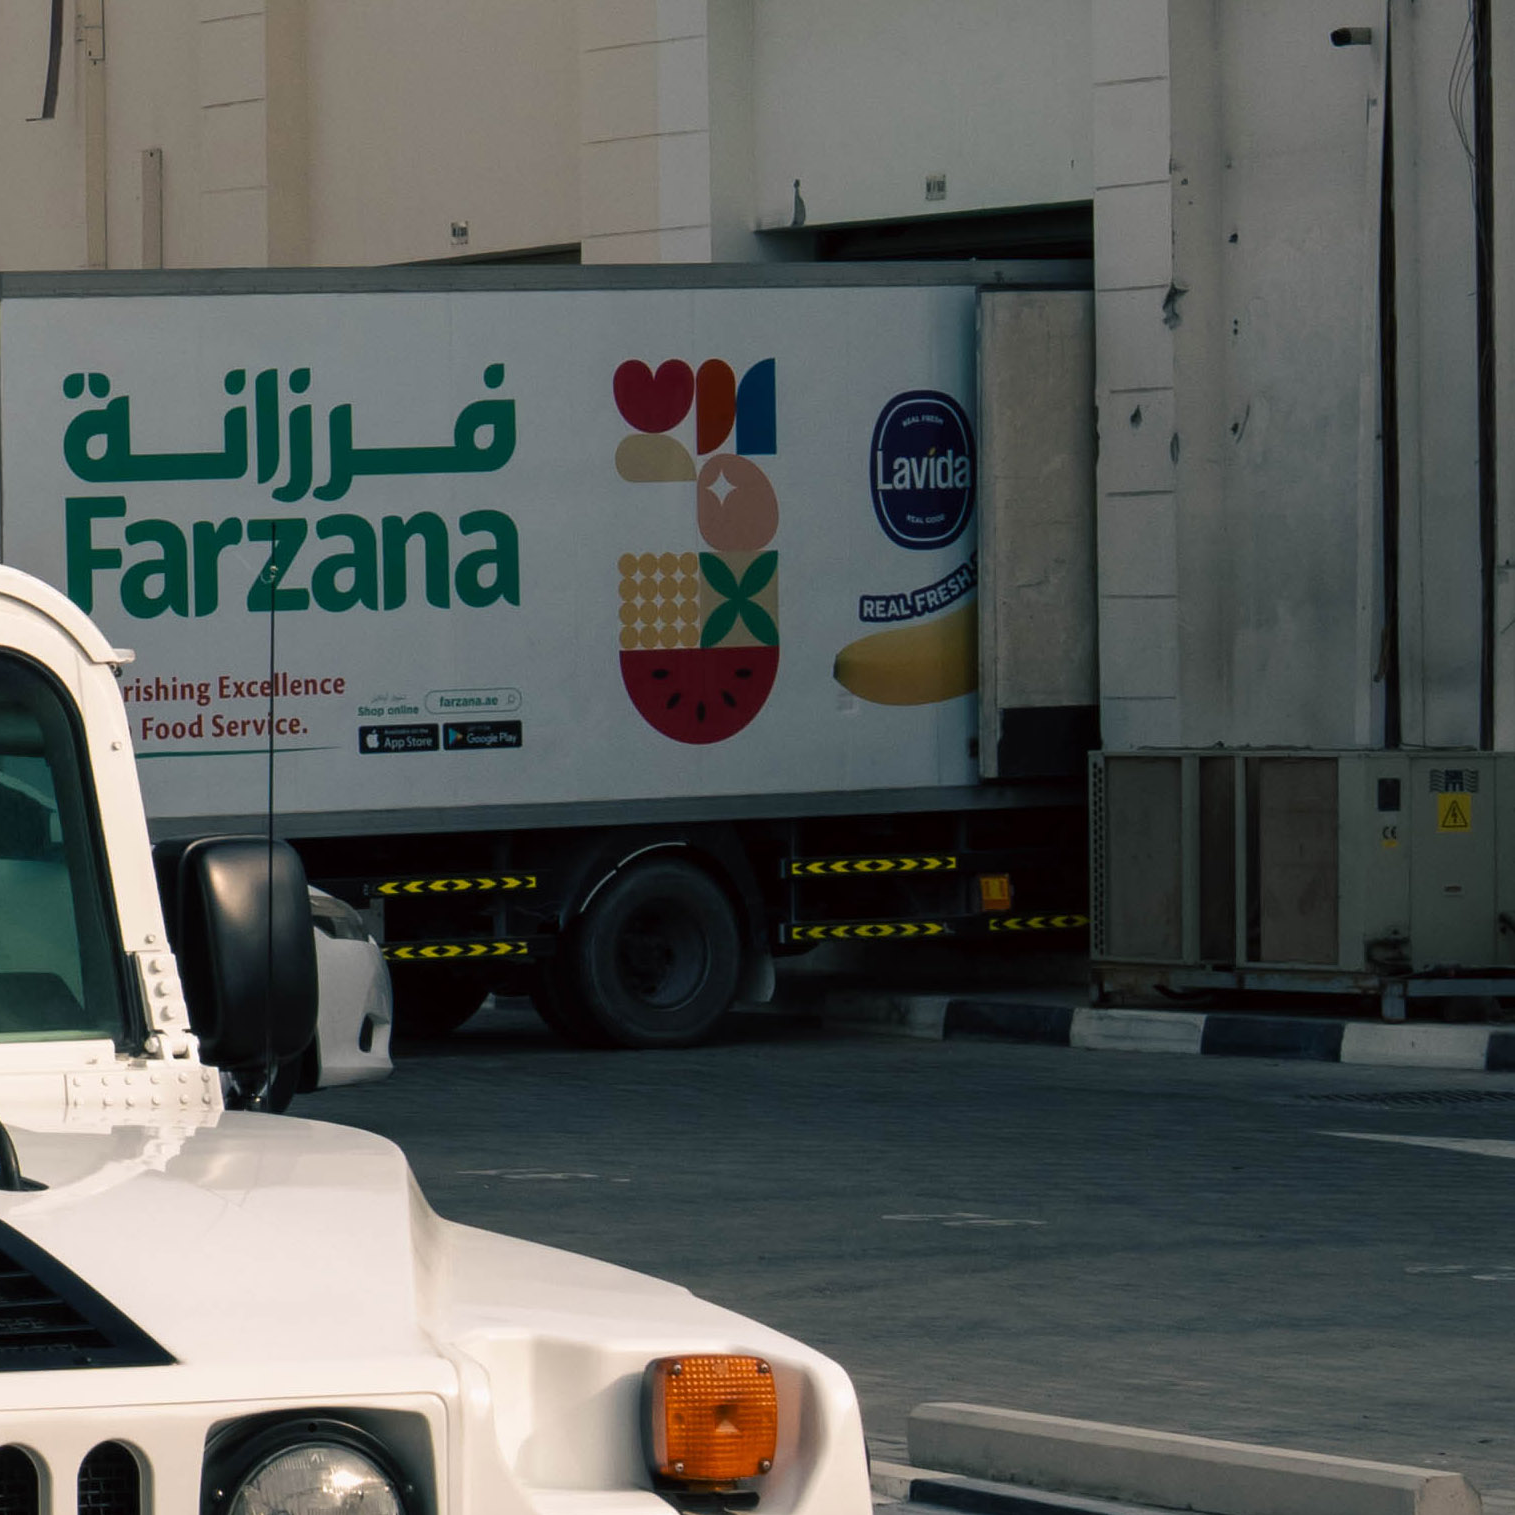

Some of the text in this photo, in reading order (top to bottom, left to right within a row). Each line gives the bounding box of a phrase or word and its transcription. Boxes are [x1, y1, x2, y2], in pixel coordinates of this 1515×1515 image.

[63, 363, 516, 502] فرزانة
[65, 495, 521, 619] Farzana
[862, 569, 970, 619] REAL FRESH
[123, 671, 346, 706] rishing Excellence
[439, 695, 499, 708] farzana.ae
[357, 704, 419, 717] Shop online
[141, 713, 204, 741] Food
[384, 735, 433, 749] App Store
